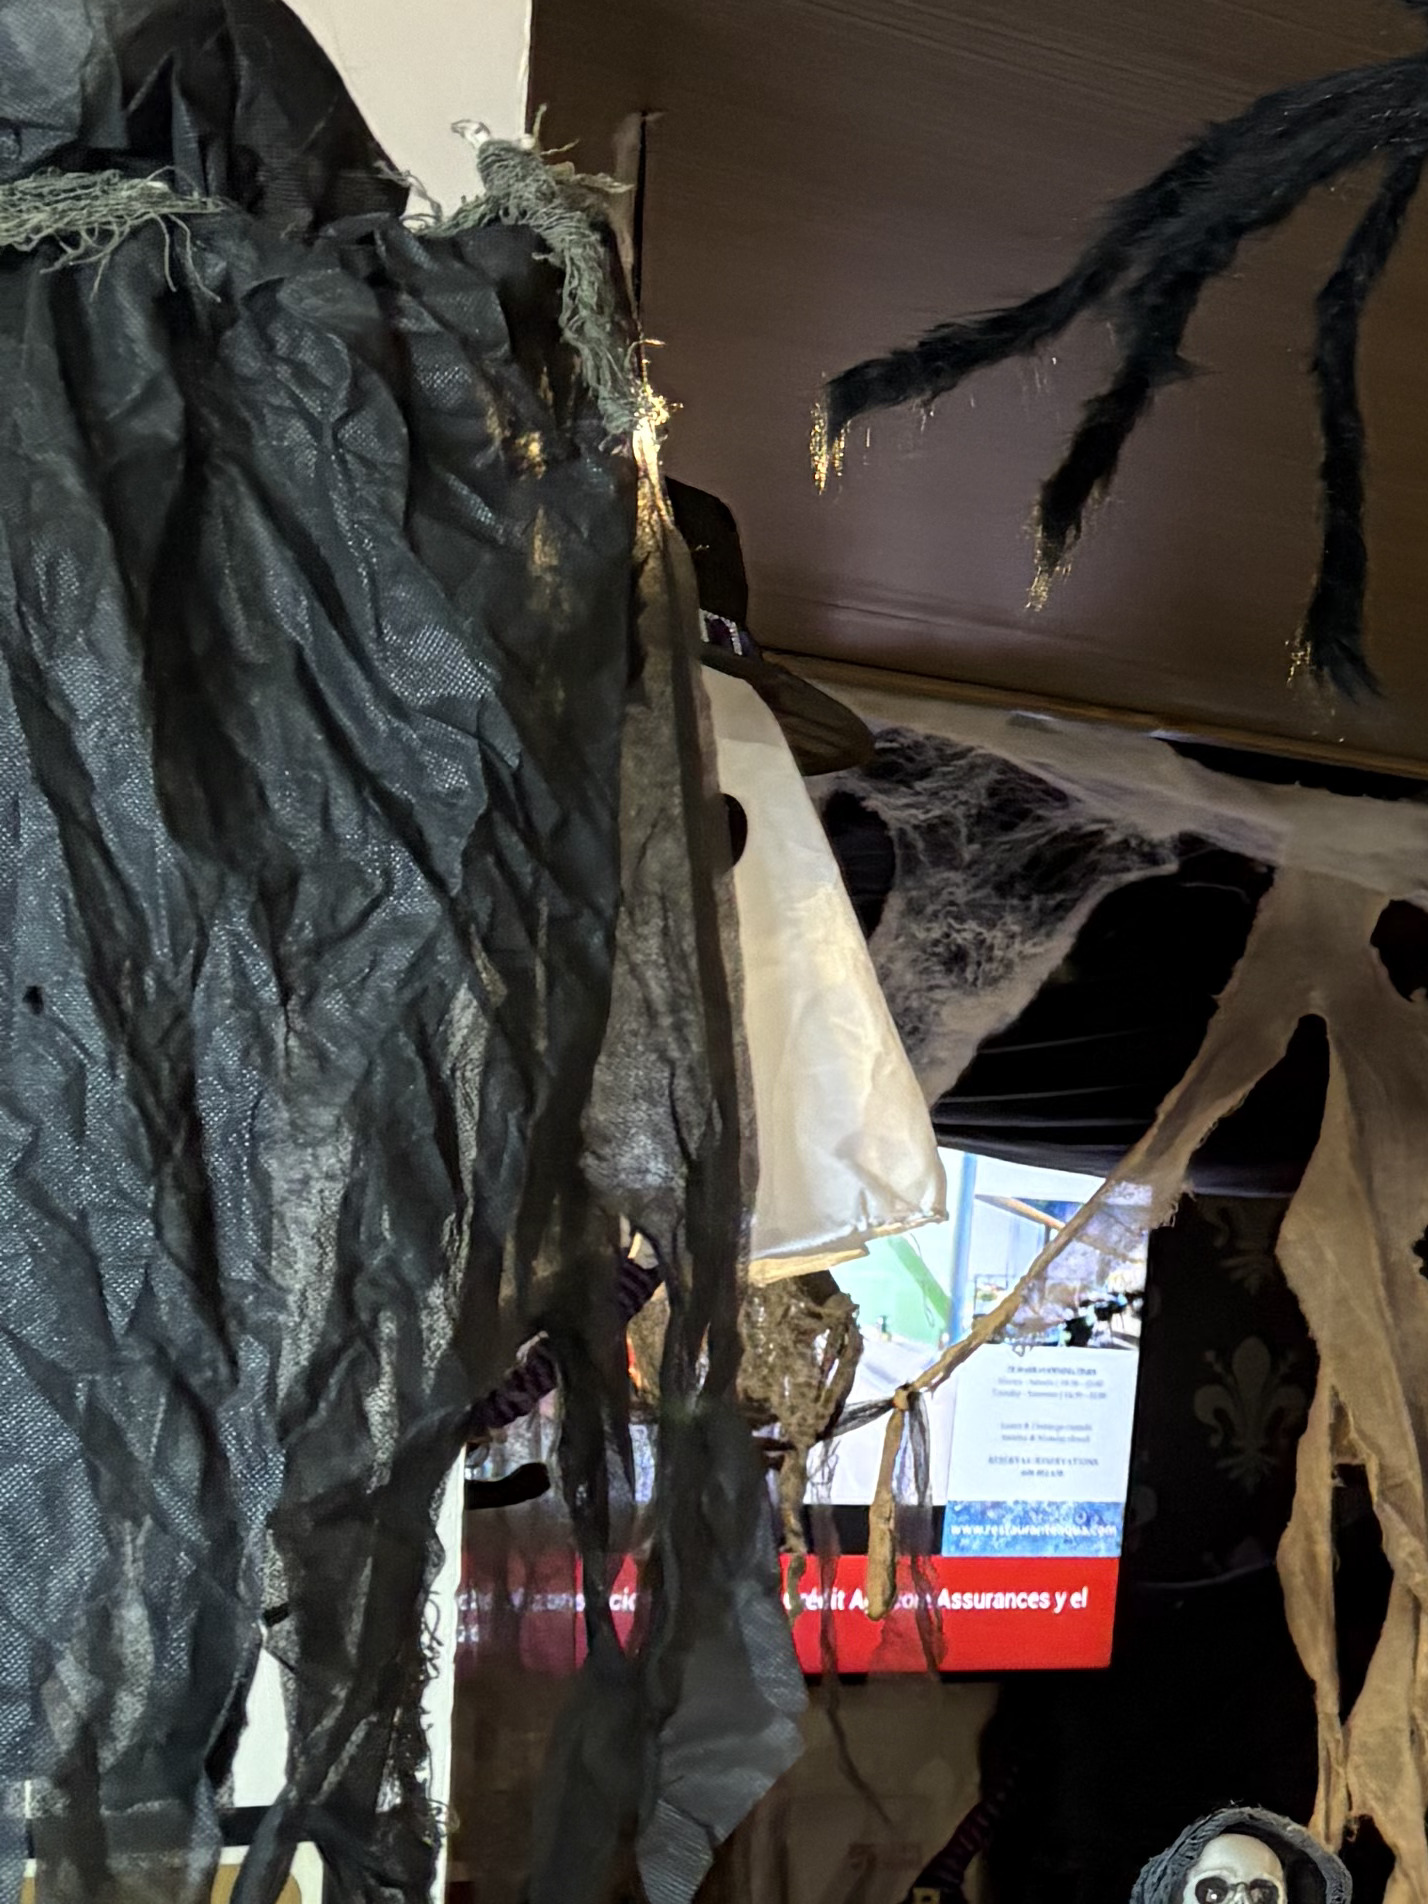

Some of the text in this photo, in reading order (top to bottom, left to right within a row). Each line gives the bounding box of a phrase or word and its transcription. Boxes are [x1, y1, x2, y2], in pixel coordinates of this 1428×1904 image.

[937, 1588, 1051, 1610] Assurances
[1053, 1591, 1067, 1614] y
[1070, 1585, 1089, 1609] el
